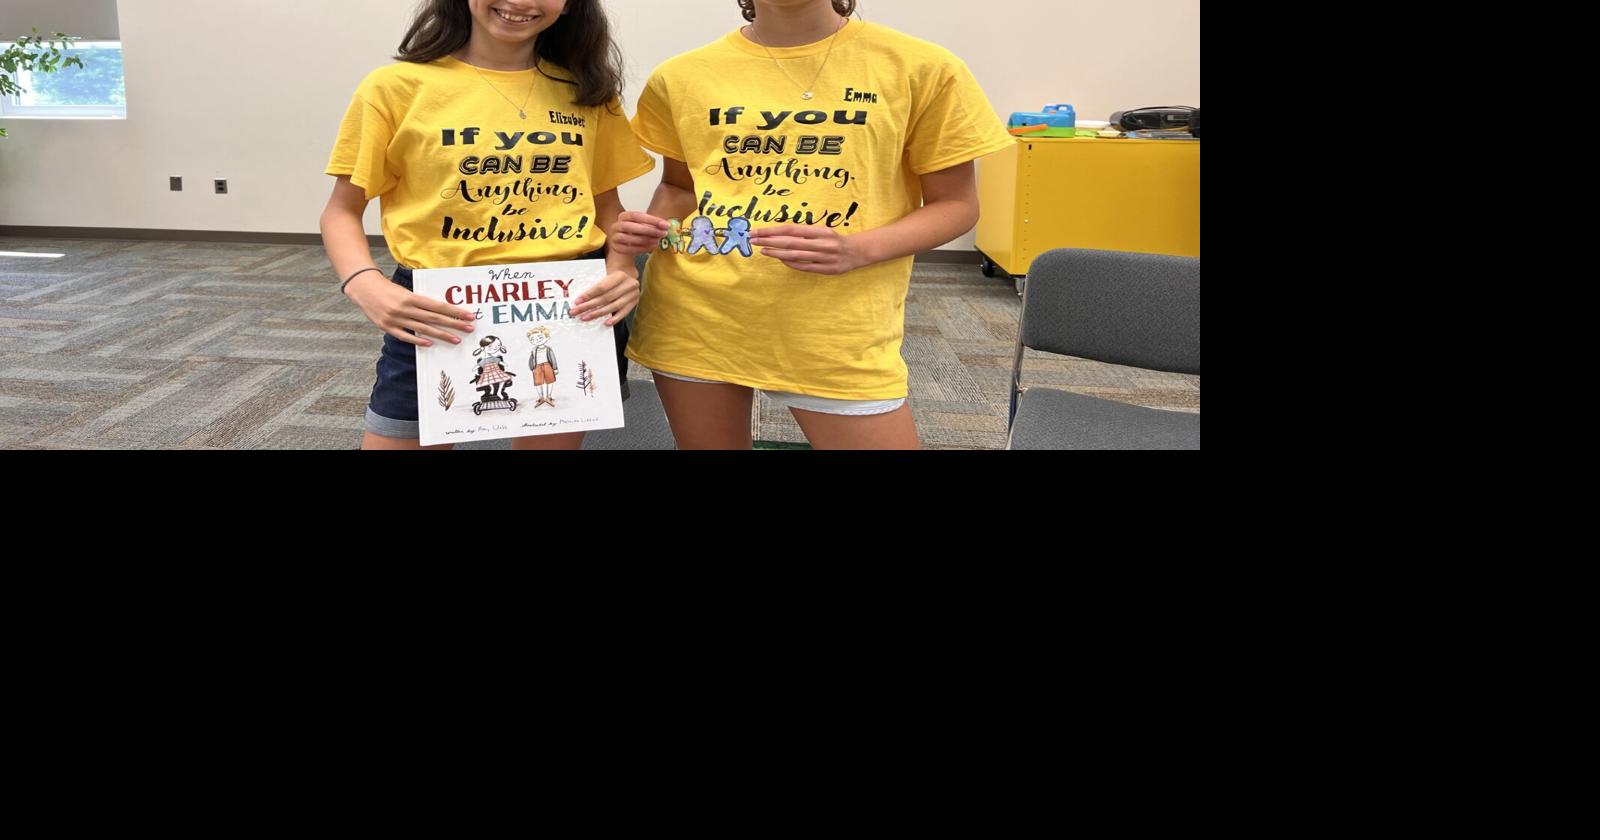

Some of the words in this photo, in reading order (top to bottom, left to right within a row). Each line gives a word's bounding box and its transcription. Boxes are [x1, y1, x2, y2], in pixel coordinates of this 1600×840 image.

[843, 87, 878, 104] Emma
[709, 106, 745, 126] If
[756, 110, 868, 131] you
[441, 127, 480, 146] If
[494, 131, 584, 151] you
[723, 135, 786, 154] CAN
[795, 135, 845, 155] BE
[458, 155, 523, 175] CAN
[529, 155, 572, 174] BE
[705, 157, 856, 189] Anything.
[440, 177, 584, 205] Anything.
[762, 184, 793, 196] be
[501, 203, 529, 216] be
[698, 190, 859, 228] Inclusive!
[441, 215, 589, 243] Inclusive!
[488, 267, 535, 282] When
[444, 278, 575, 306] CHARLEY
[492, 300, 576, 325] EMMA
